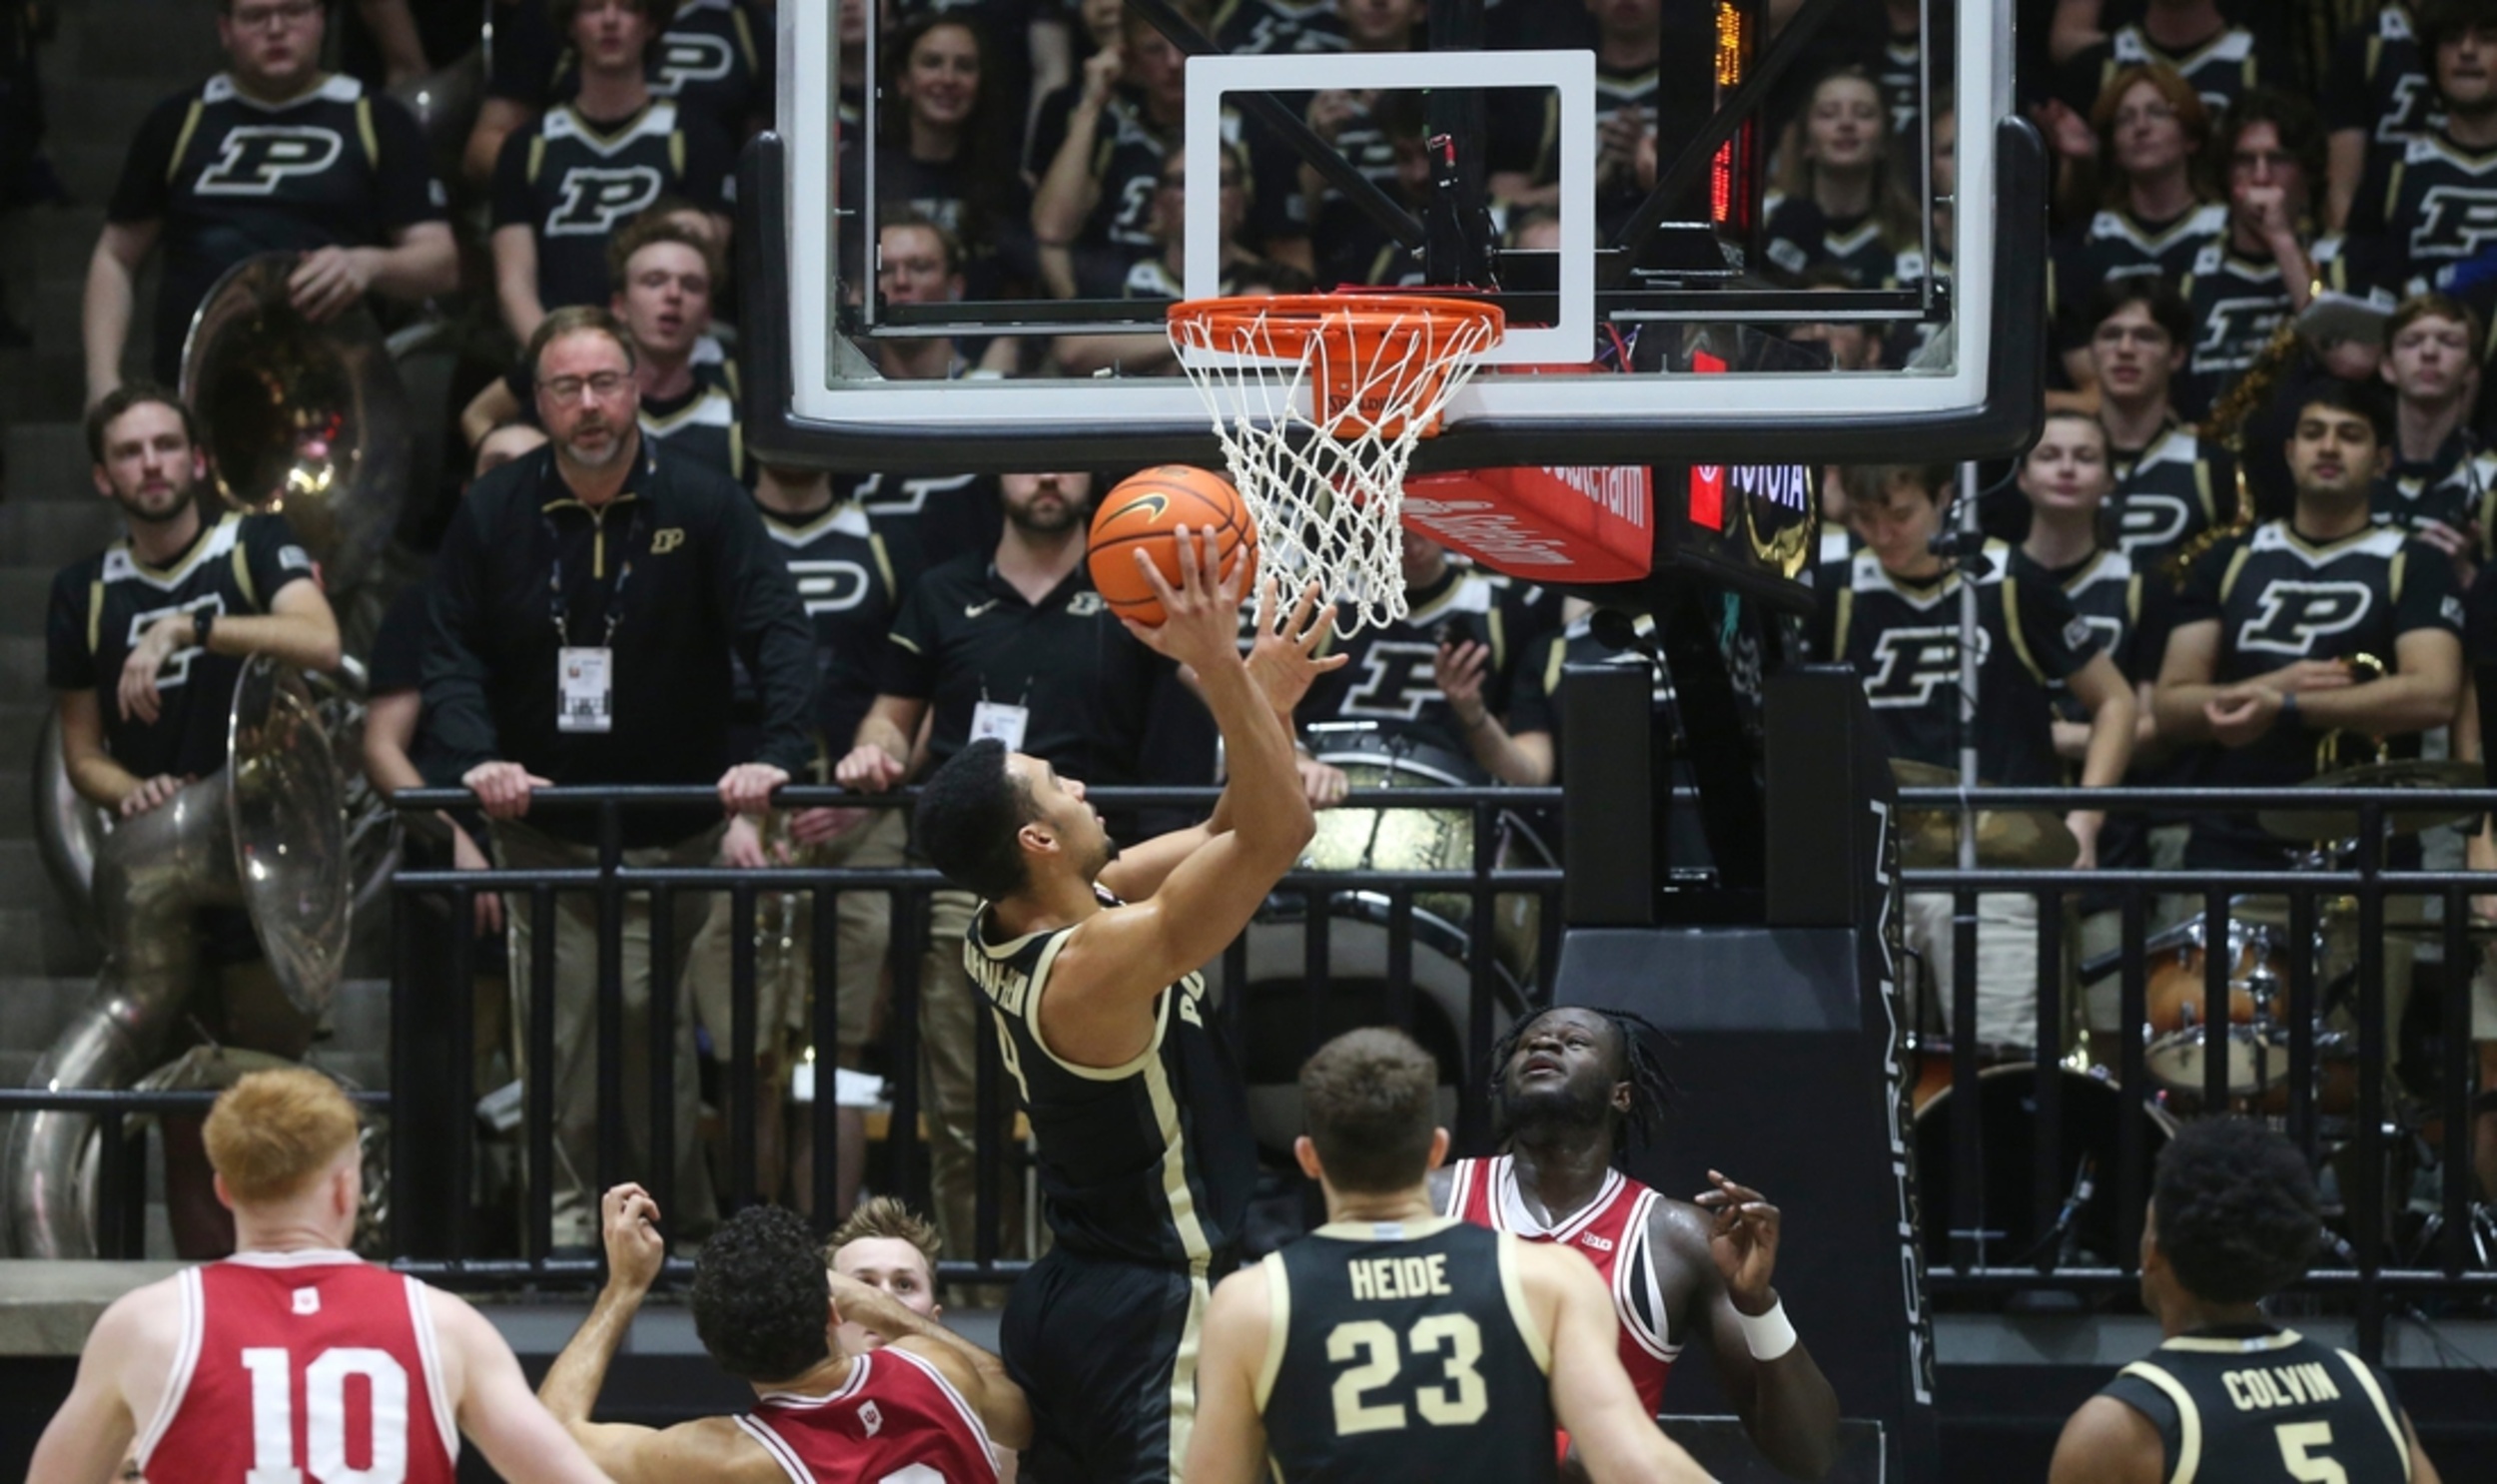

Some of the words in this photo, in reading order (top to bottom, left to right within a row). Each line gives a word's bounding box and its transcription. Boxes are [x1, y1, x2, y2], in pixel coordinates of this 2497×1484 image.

[195, 126, 343, 195] P
[545, 165, 661, 237] P
[2237, 580, 2372, 654] P
[1348, 1253, 1452, 1300] HEIDE
[1325, 1312, 1488, 1436] 23
[2221, 1361, 2340, 1410] COLVIN
[241, 1347, 410, 1484] 10
[2274, 1420, 2348, 1484] 5
